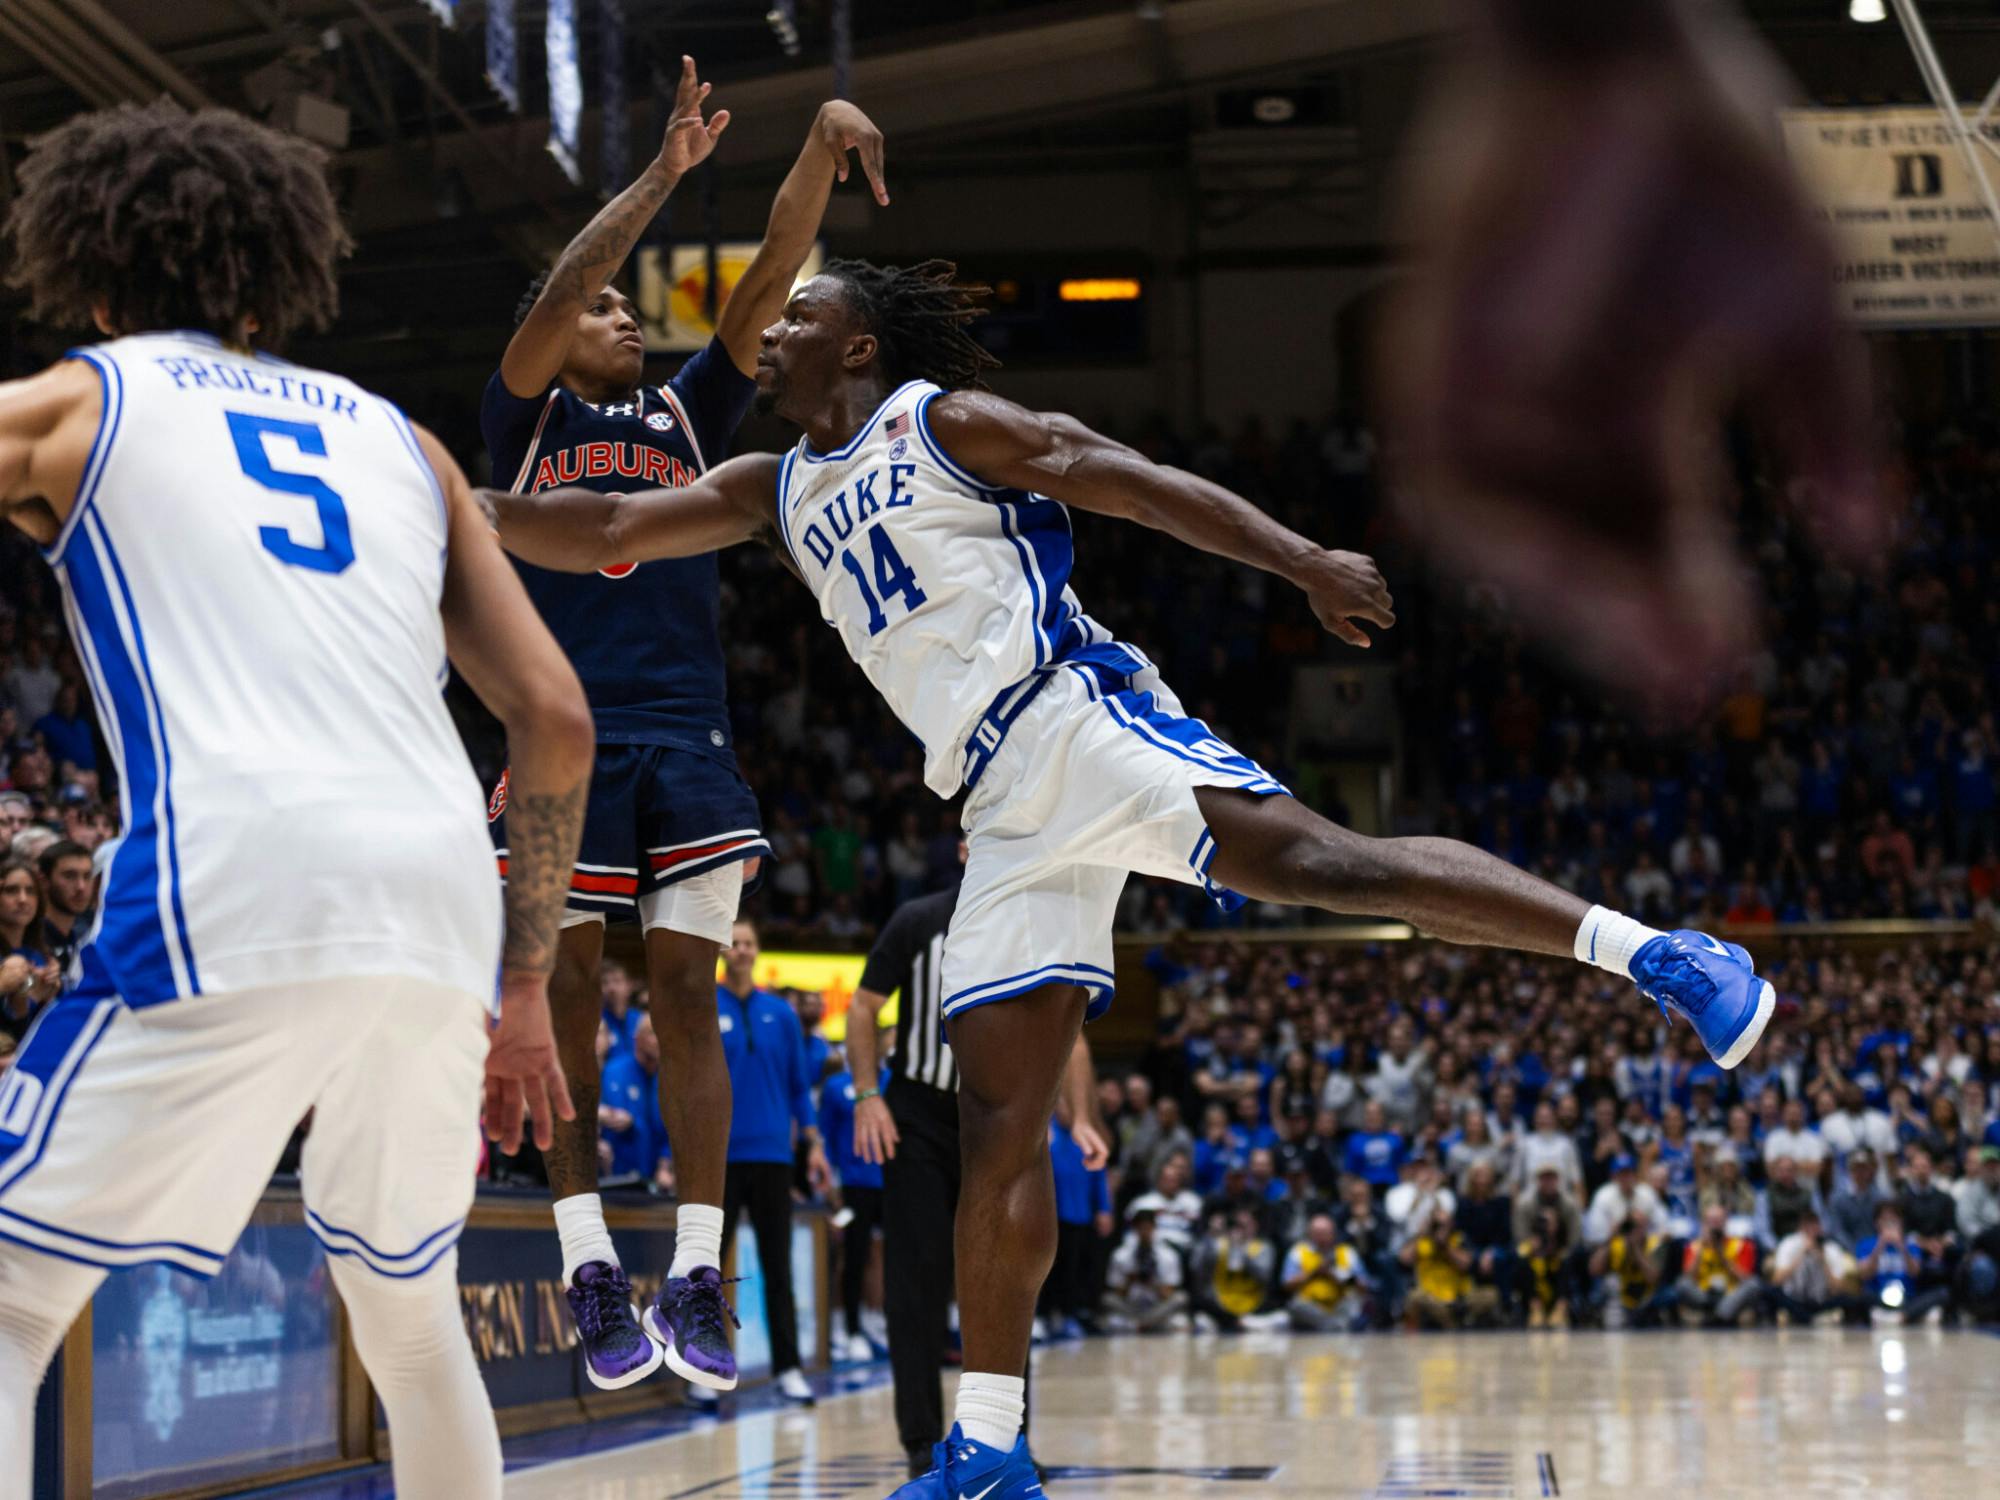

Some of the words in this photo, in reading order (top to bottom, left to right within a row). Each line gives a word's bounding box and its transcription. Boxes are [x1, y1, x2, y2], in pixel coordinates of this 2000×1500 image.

[1893, 154, 1941, 197] D
[155, 357, 358, 421] PROCTOR
[224, 410, 356, 575] 5
[530, 441, 698, 495] AUBURN
[803, 463, 916, 571] DUKE
[842, 522, 928, 637] 14
